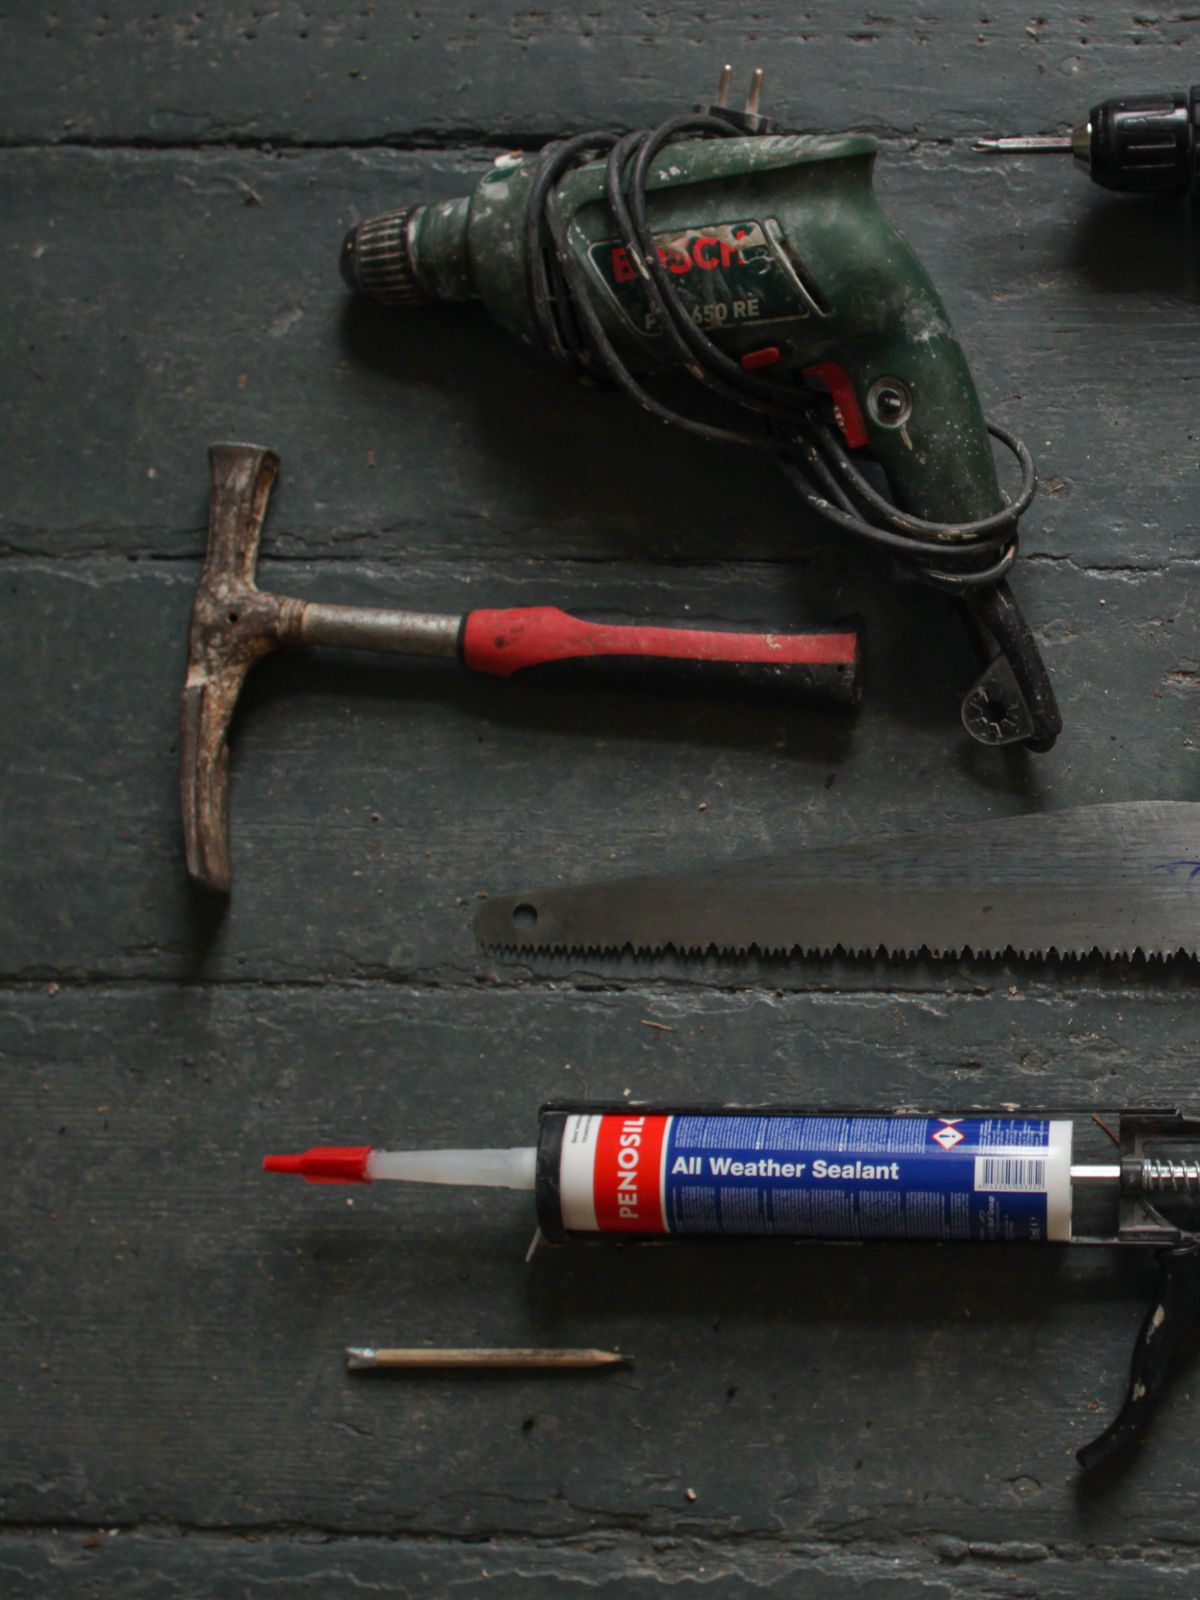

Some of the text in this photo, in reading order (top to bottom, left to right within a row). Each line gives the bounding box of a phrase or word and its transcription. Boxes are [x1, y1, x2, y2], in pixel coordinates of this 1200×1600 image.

[692, 298, 761, 324] 650 RE
[617, 1116, 646, 1219] PENOSIL
[671, 1157, 900, 1181] All Weather Sealant
